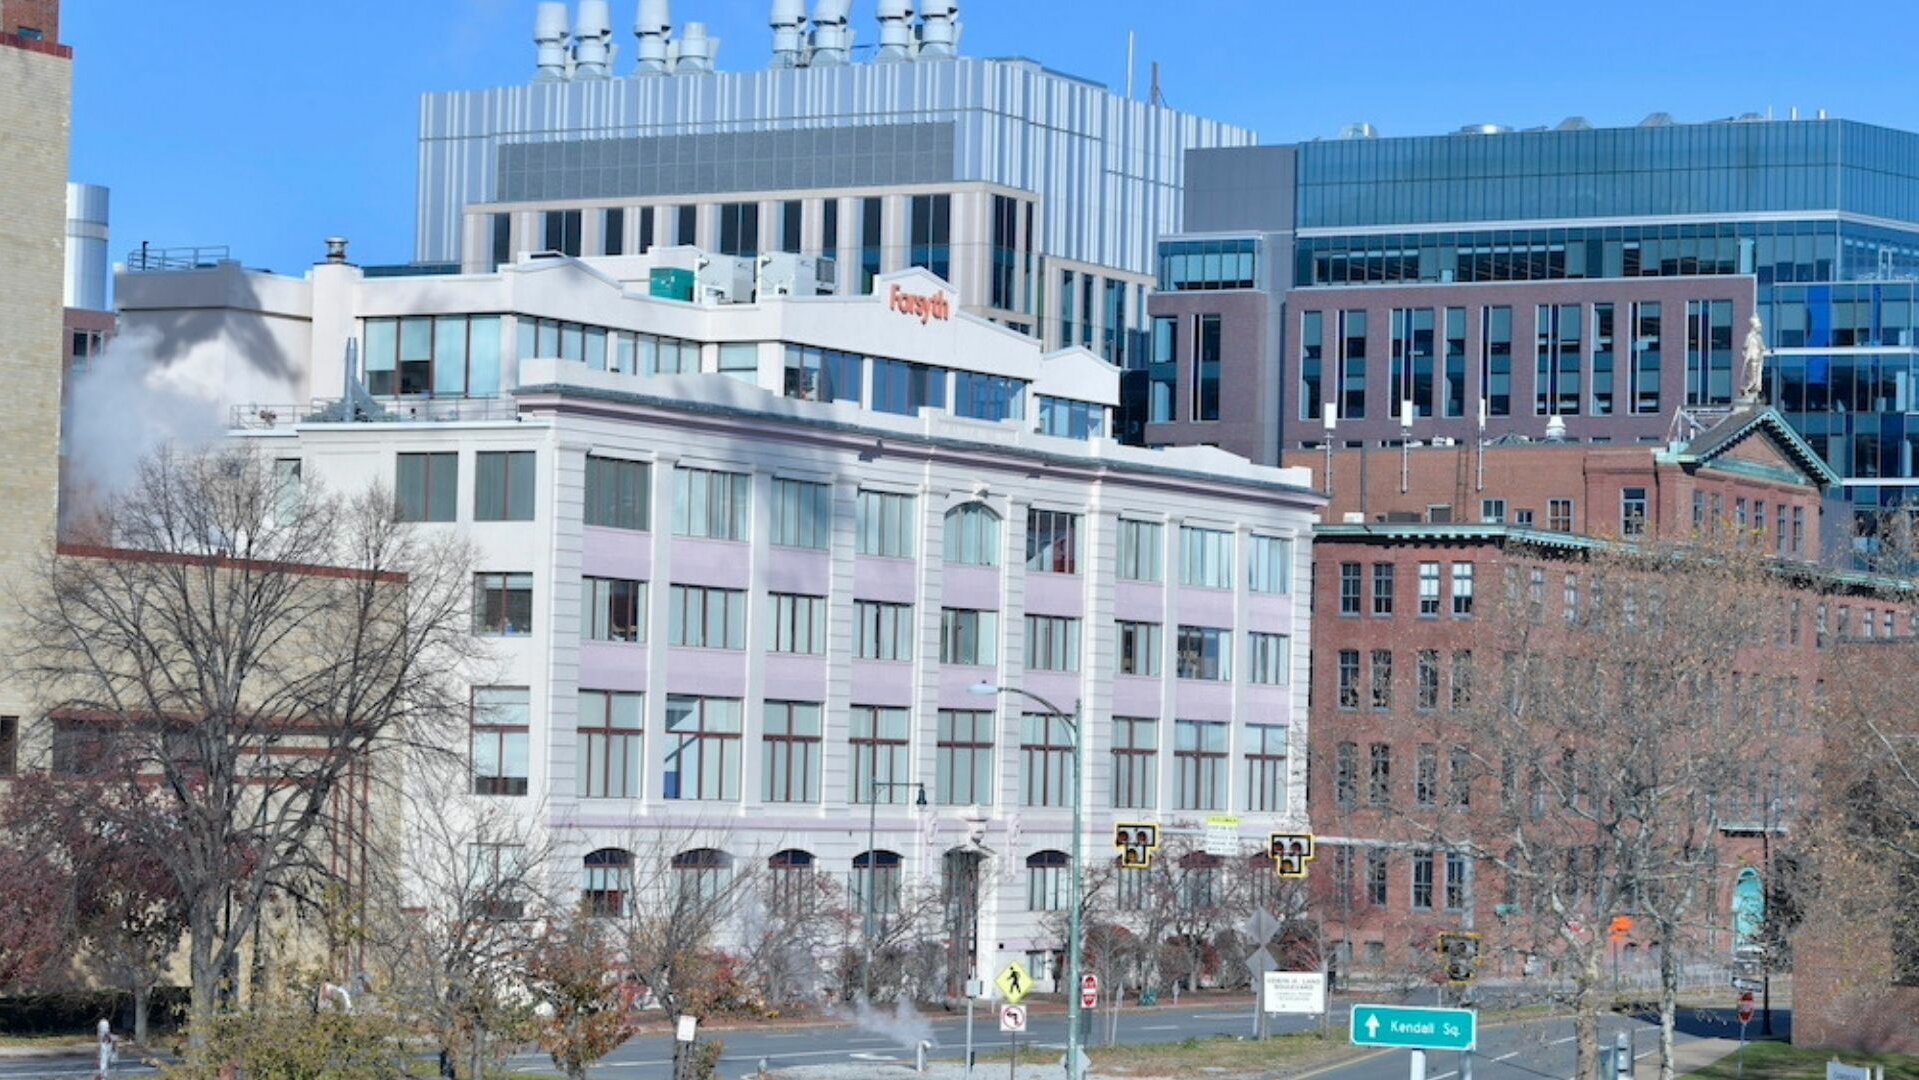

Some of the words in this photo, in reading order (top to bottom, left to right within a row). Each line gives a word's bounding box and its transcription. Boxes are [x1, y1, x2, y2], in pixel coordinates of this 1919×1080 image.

[889, 283, 949, 325] Forsyth
[1390, 1019, 1435, 1035] Kendall
[1442, 1022, 1461, 1038] Sq.
